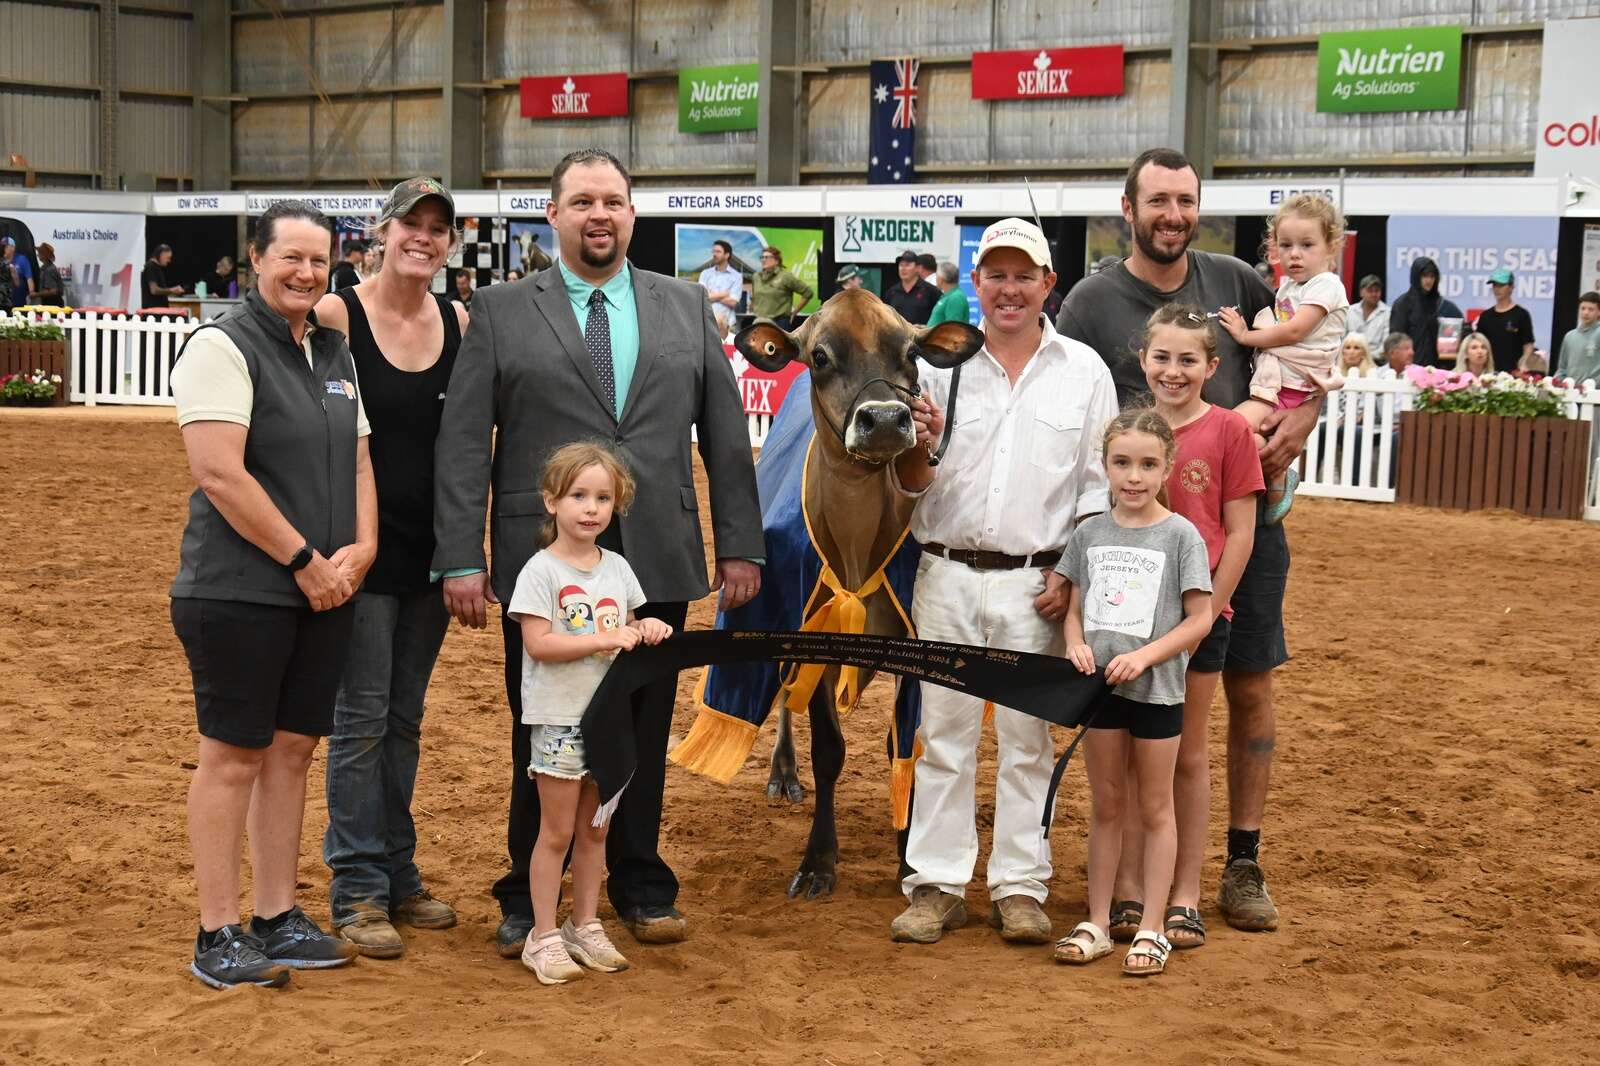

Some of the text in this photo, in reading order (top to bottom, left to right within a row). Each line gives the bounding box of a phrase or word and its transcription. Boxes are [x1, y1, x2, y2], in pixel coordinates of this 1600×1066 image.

[1336, 44, 1445, 76] Nutrien
[690, 77, 759, 103] Nutrien
[1018, 69, 1069, 95] SEMEX
[1332, 80, 1416, 100] Ag Solutions
[552, 93, 589, 114] SEMEX
[688, 105, 742, 122] Ag Solutions
[178, 198, 219, 209] IDW OFFICE
[342, 198, 372, 209] EXPORT
[668, 195, 763, 209] ENTEGRA SHEDS
[910, 195, 963, 209] NEOGEN
[53, 229, 118, 241] Australia's Choice
[860, 218, 935, 243] NEOGEN
[1445, 247, 1499, 271] THIS
[1099, 565, 1140, 575] JERSEYS
[831, 635, 856, 643] Dairy
[887, 639, 924, 648] National
[926, 643, 957, 652] Jersey
[880, 660, 925, 675] Australia
[927, 654, 950, 665] 2024
